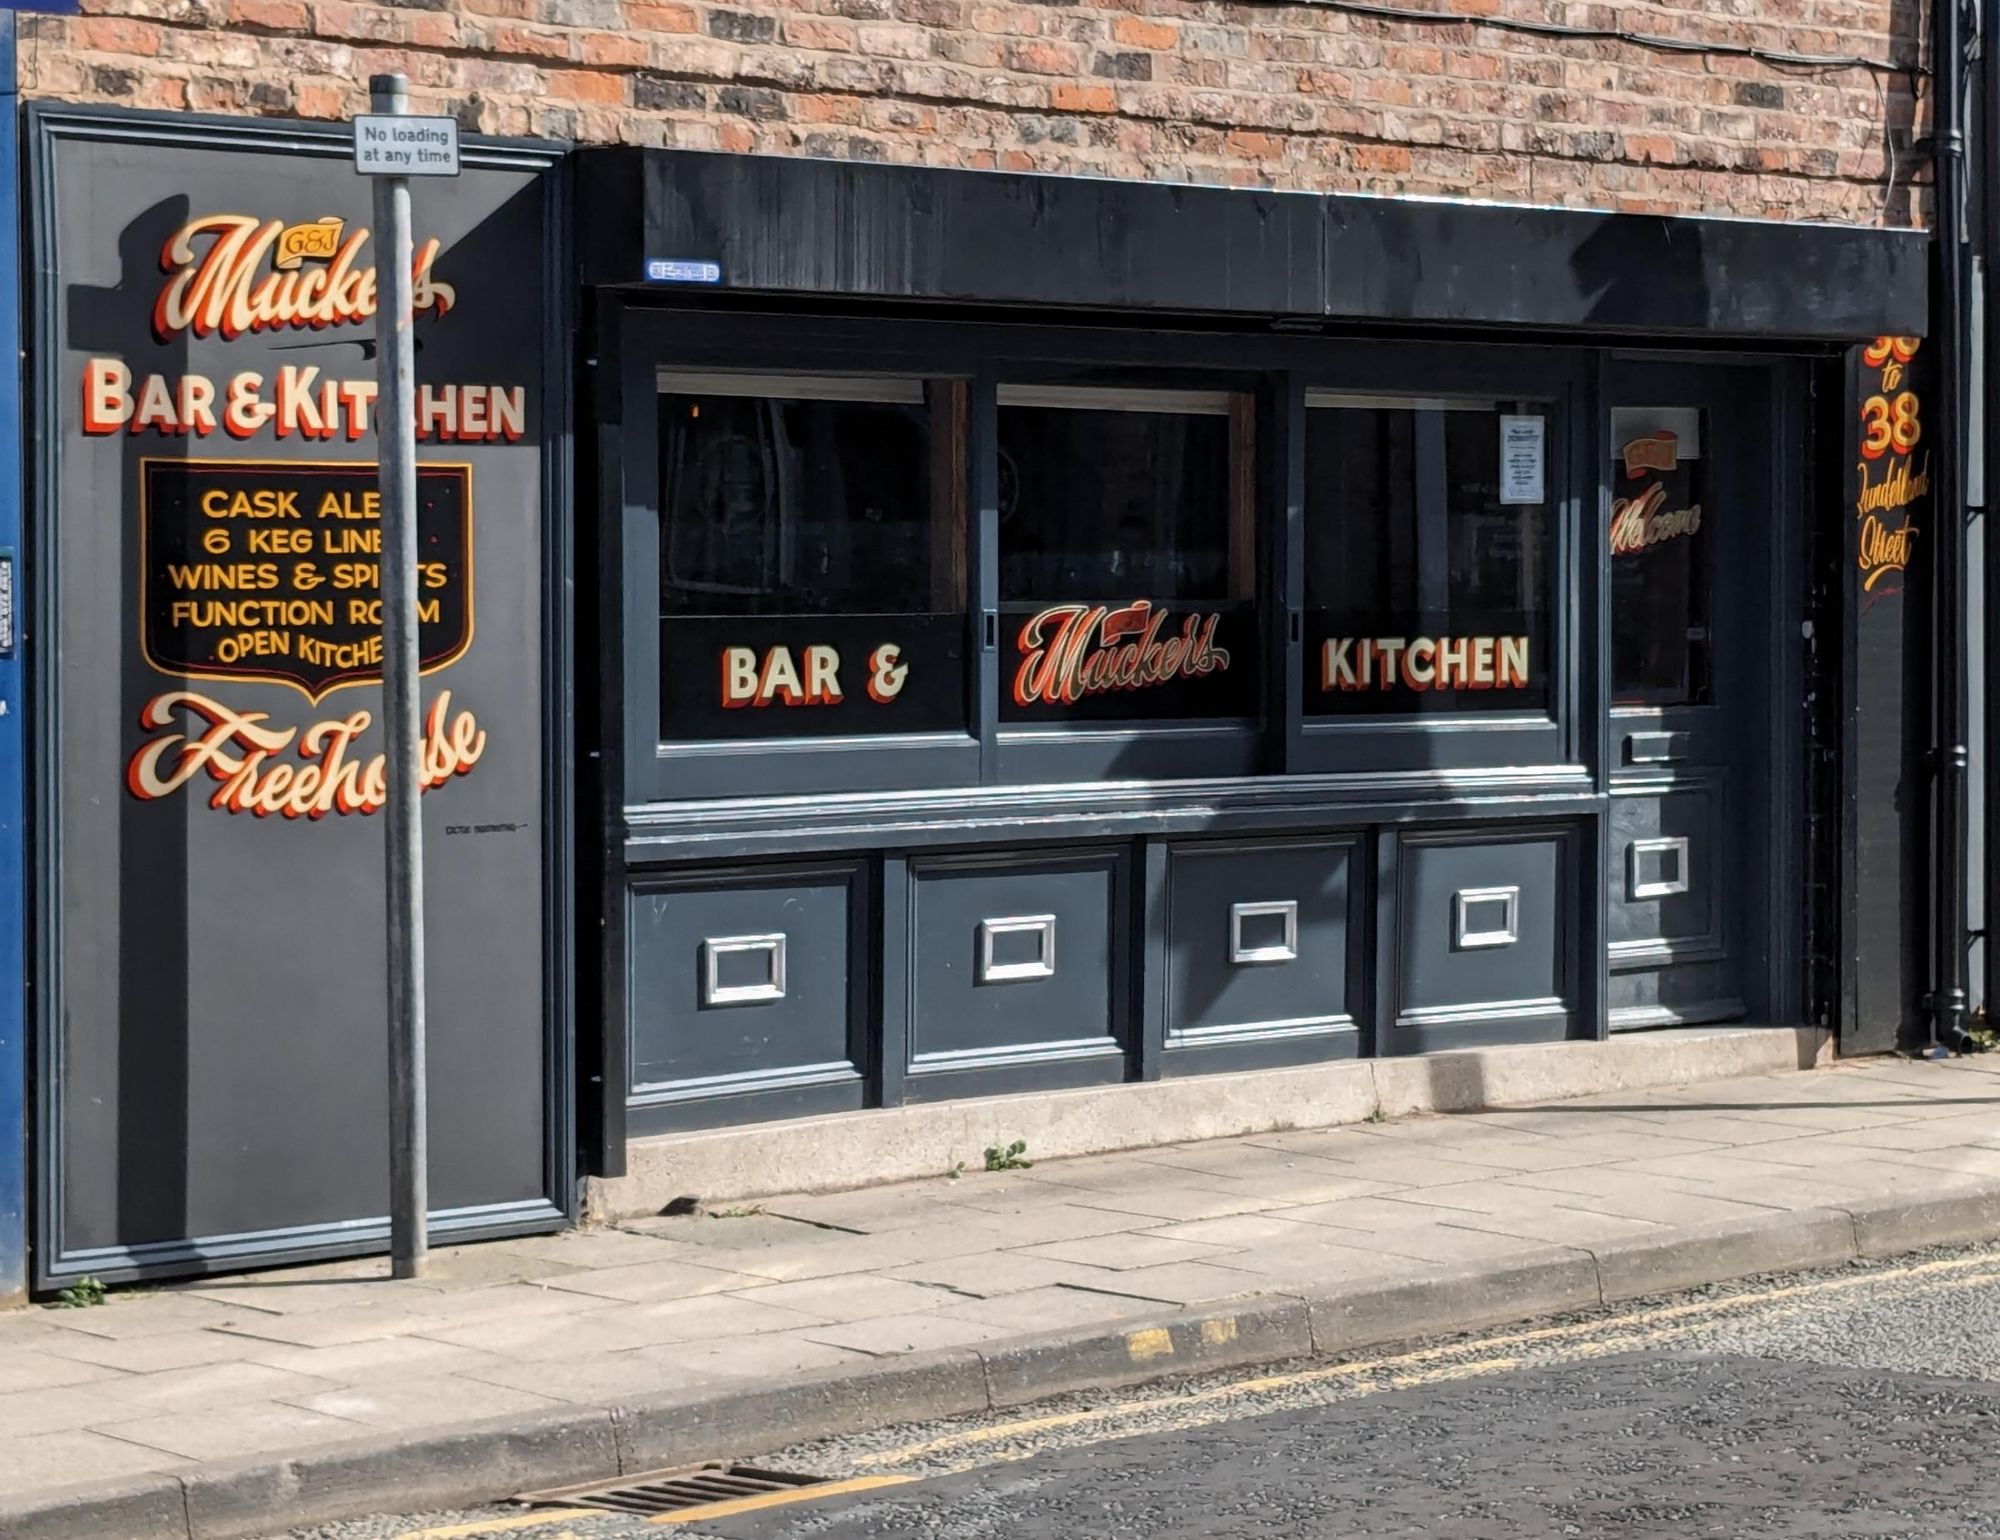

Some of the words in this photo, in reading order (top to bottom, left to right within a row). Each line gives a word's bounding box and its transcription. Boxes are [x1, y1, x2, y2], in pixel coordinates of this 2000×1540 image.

[364, 127, 387, 142] No
[392, 128, 449, 146] loading
[364, 148, 380, 162] at
[385, 150, 412, 165] any
[417, 149, 451, 163] time
[285, 229, 335, 252] G&J
[156, 214, 456, 341] Muckes
[1881, 358, 1903, 393] to
[224, 371, 276, 439] &
[275, 365, 526, 441] KITHEN
[1862, 392, 1921, 459] 38
[202, 491, 302, 519] CASK
[318, 492, 381, 519] ALE
[204, 529, 231, 554] 6
[250, 529, 313, 553] KEG
[324, 529, 381, 554] LINE
[1858, 515, 1920, 570] Street
[168, 564, 280, 590] WINES
[293, 562, 326, 590] &
[172, 600, 334, 627] FUNCTION
[350, 600, 440, 626] ROM
[218, 631, 289, 663] OPEN
[299, 634, 383, 668] KITCHE
[1322, 637, 1529, 692] KITCHEN
[722, 646, 844, 708] BAR
[867, 643, 909, 704] &
